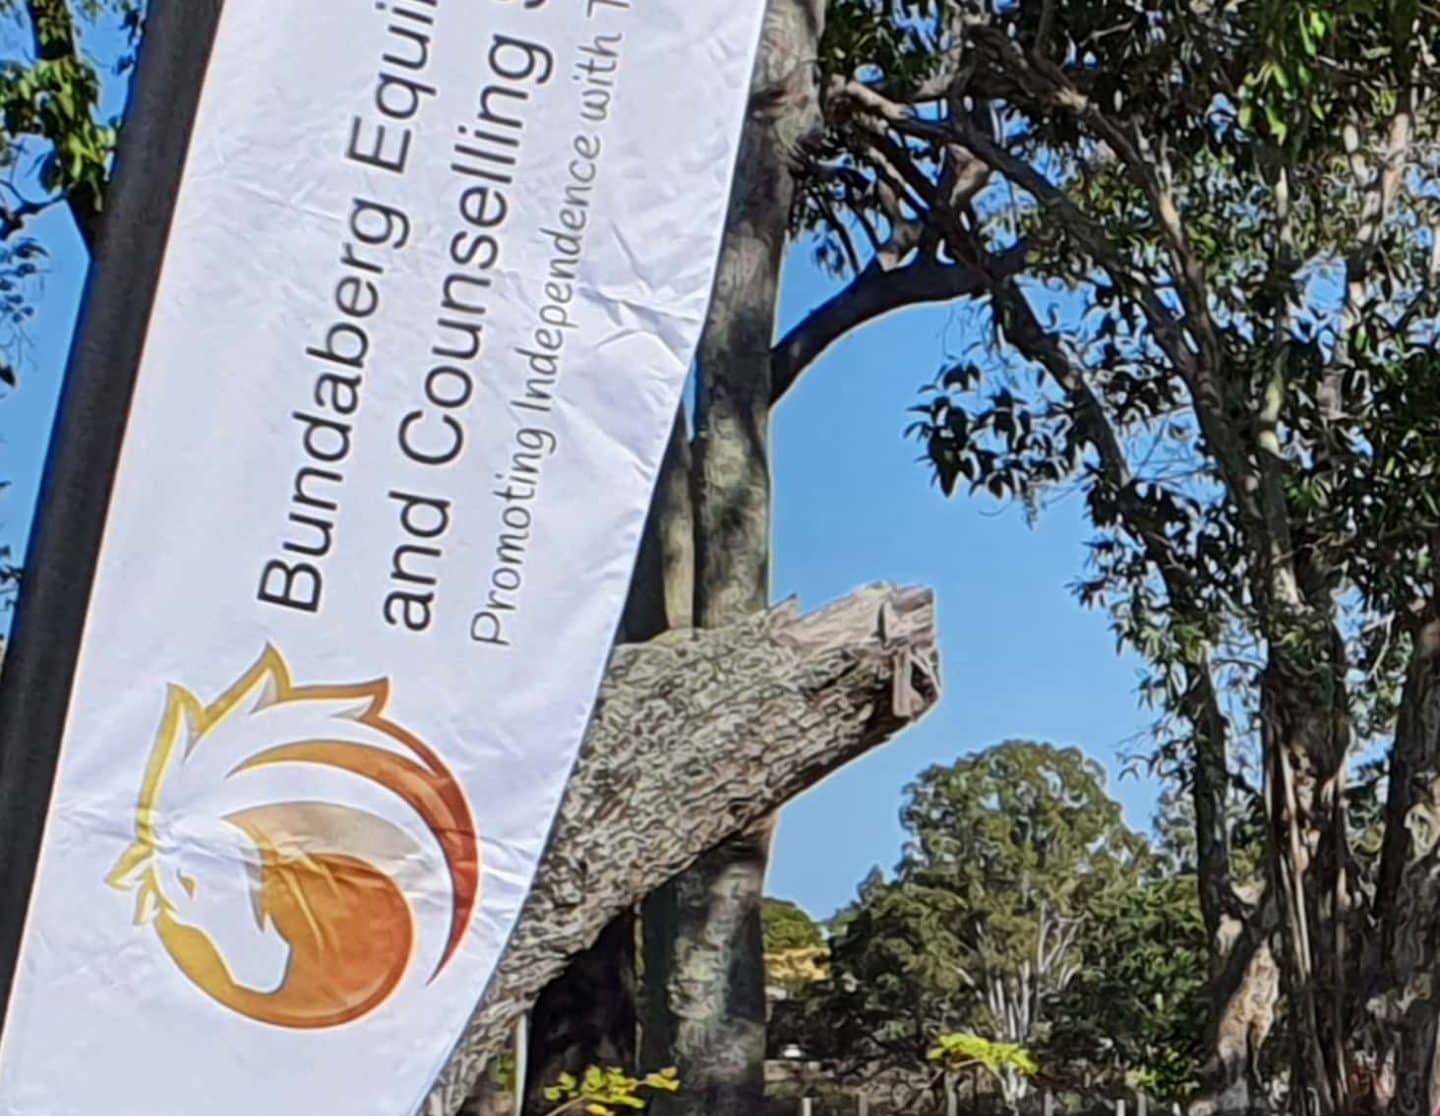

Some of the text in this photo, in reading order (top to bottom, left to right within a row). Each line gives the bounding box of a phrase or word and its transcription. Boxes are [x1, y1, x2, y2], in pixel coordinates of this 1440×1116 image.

[571, 33, 622, 121] with
[257, 0, 438, 614] Bundaberg Equi
[382, 33, 554, 632] and Counselling
[510, 135, 601, 413] Independence
[469, 428, 557, 646] Promoting
